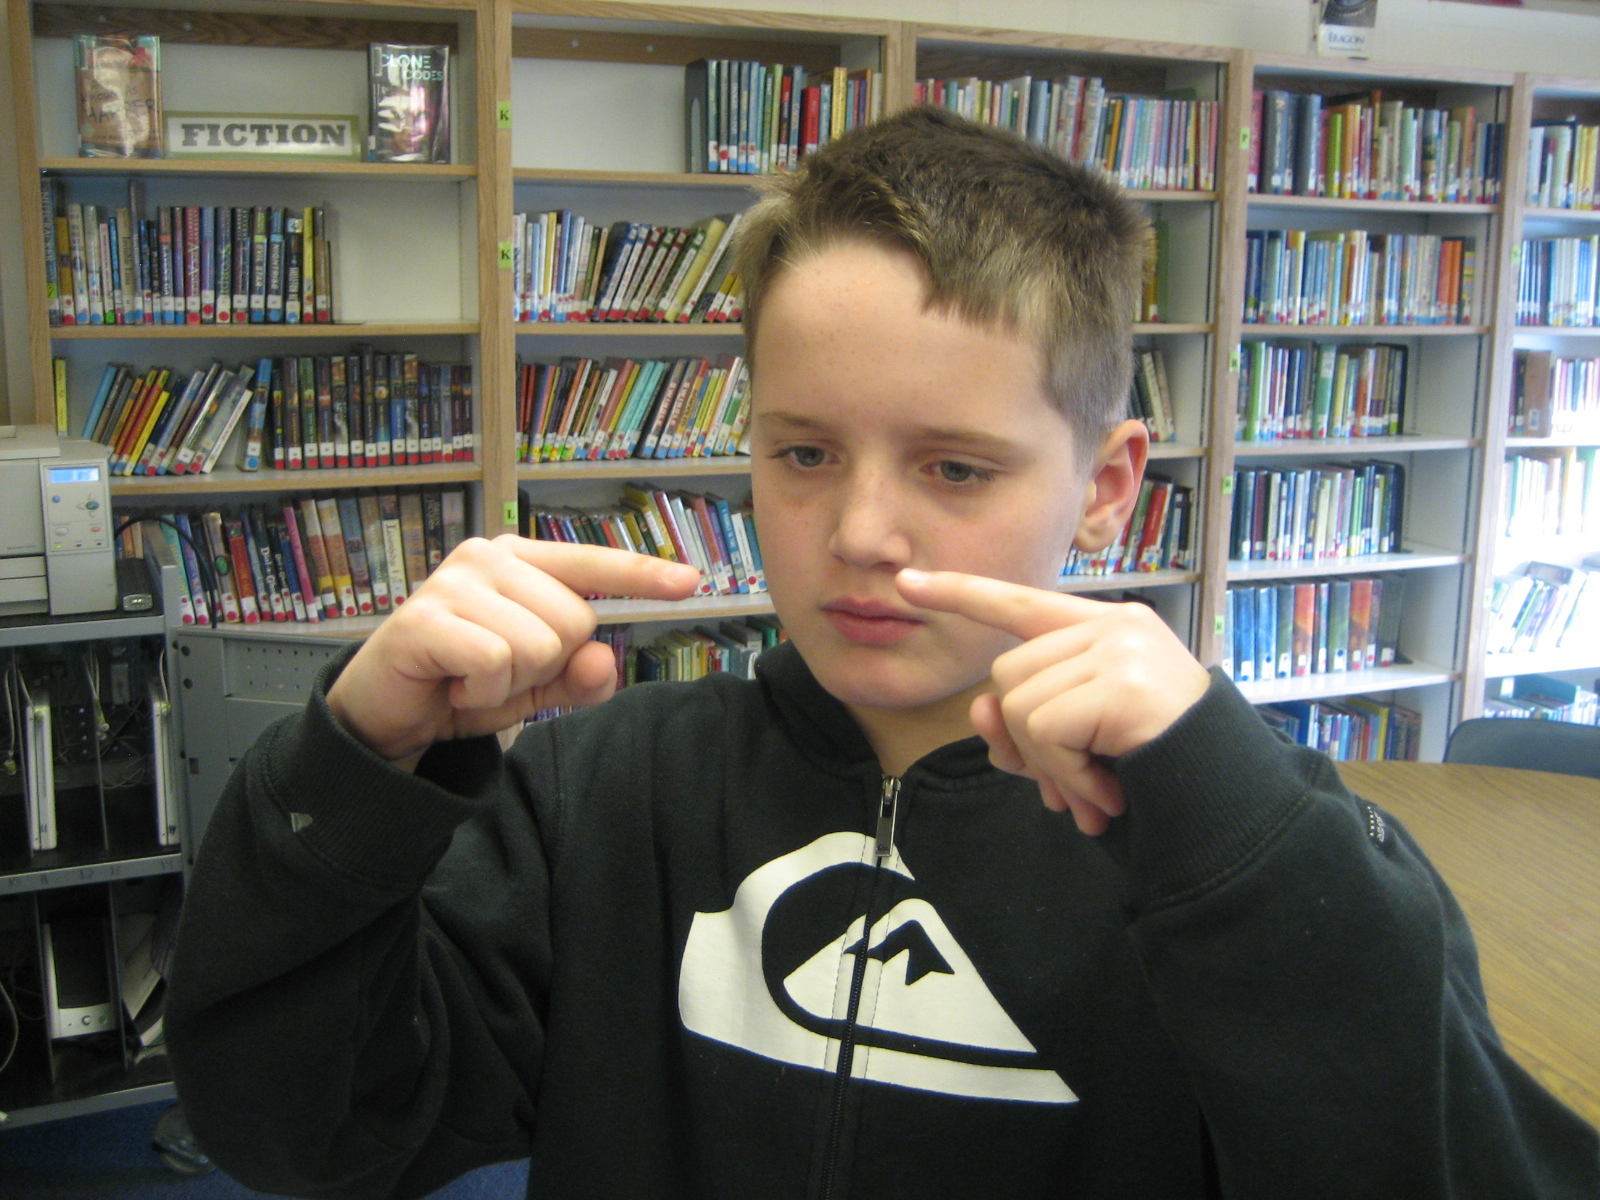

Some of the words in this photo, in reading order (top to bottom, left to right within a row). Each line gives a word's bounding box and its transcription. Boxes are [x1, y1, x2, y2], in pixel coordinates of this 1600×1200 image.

[381, 54, 431, 69] CLONE
[403, 70, 444, 81] CODES
[500, 109, 511, 121] K
[181, 124, 346, 147] FICTION
[500, 248, 511, 260] K
[271, 243, 281, 290] NIGHTRISE
[255, 265, 263, 287] STAR
[507, 510, 515, 519] L
